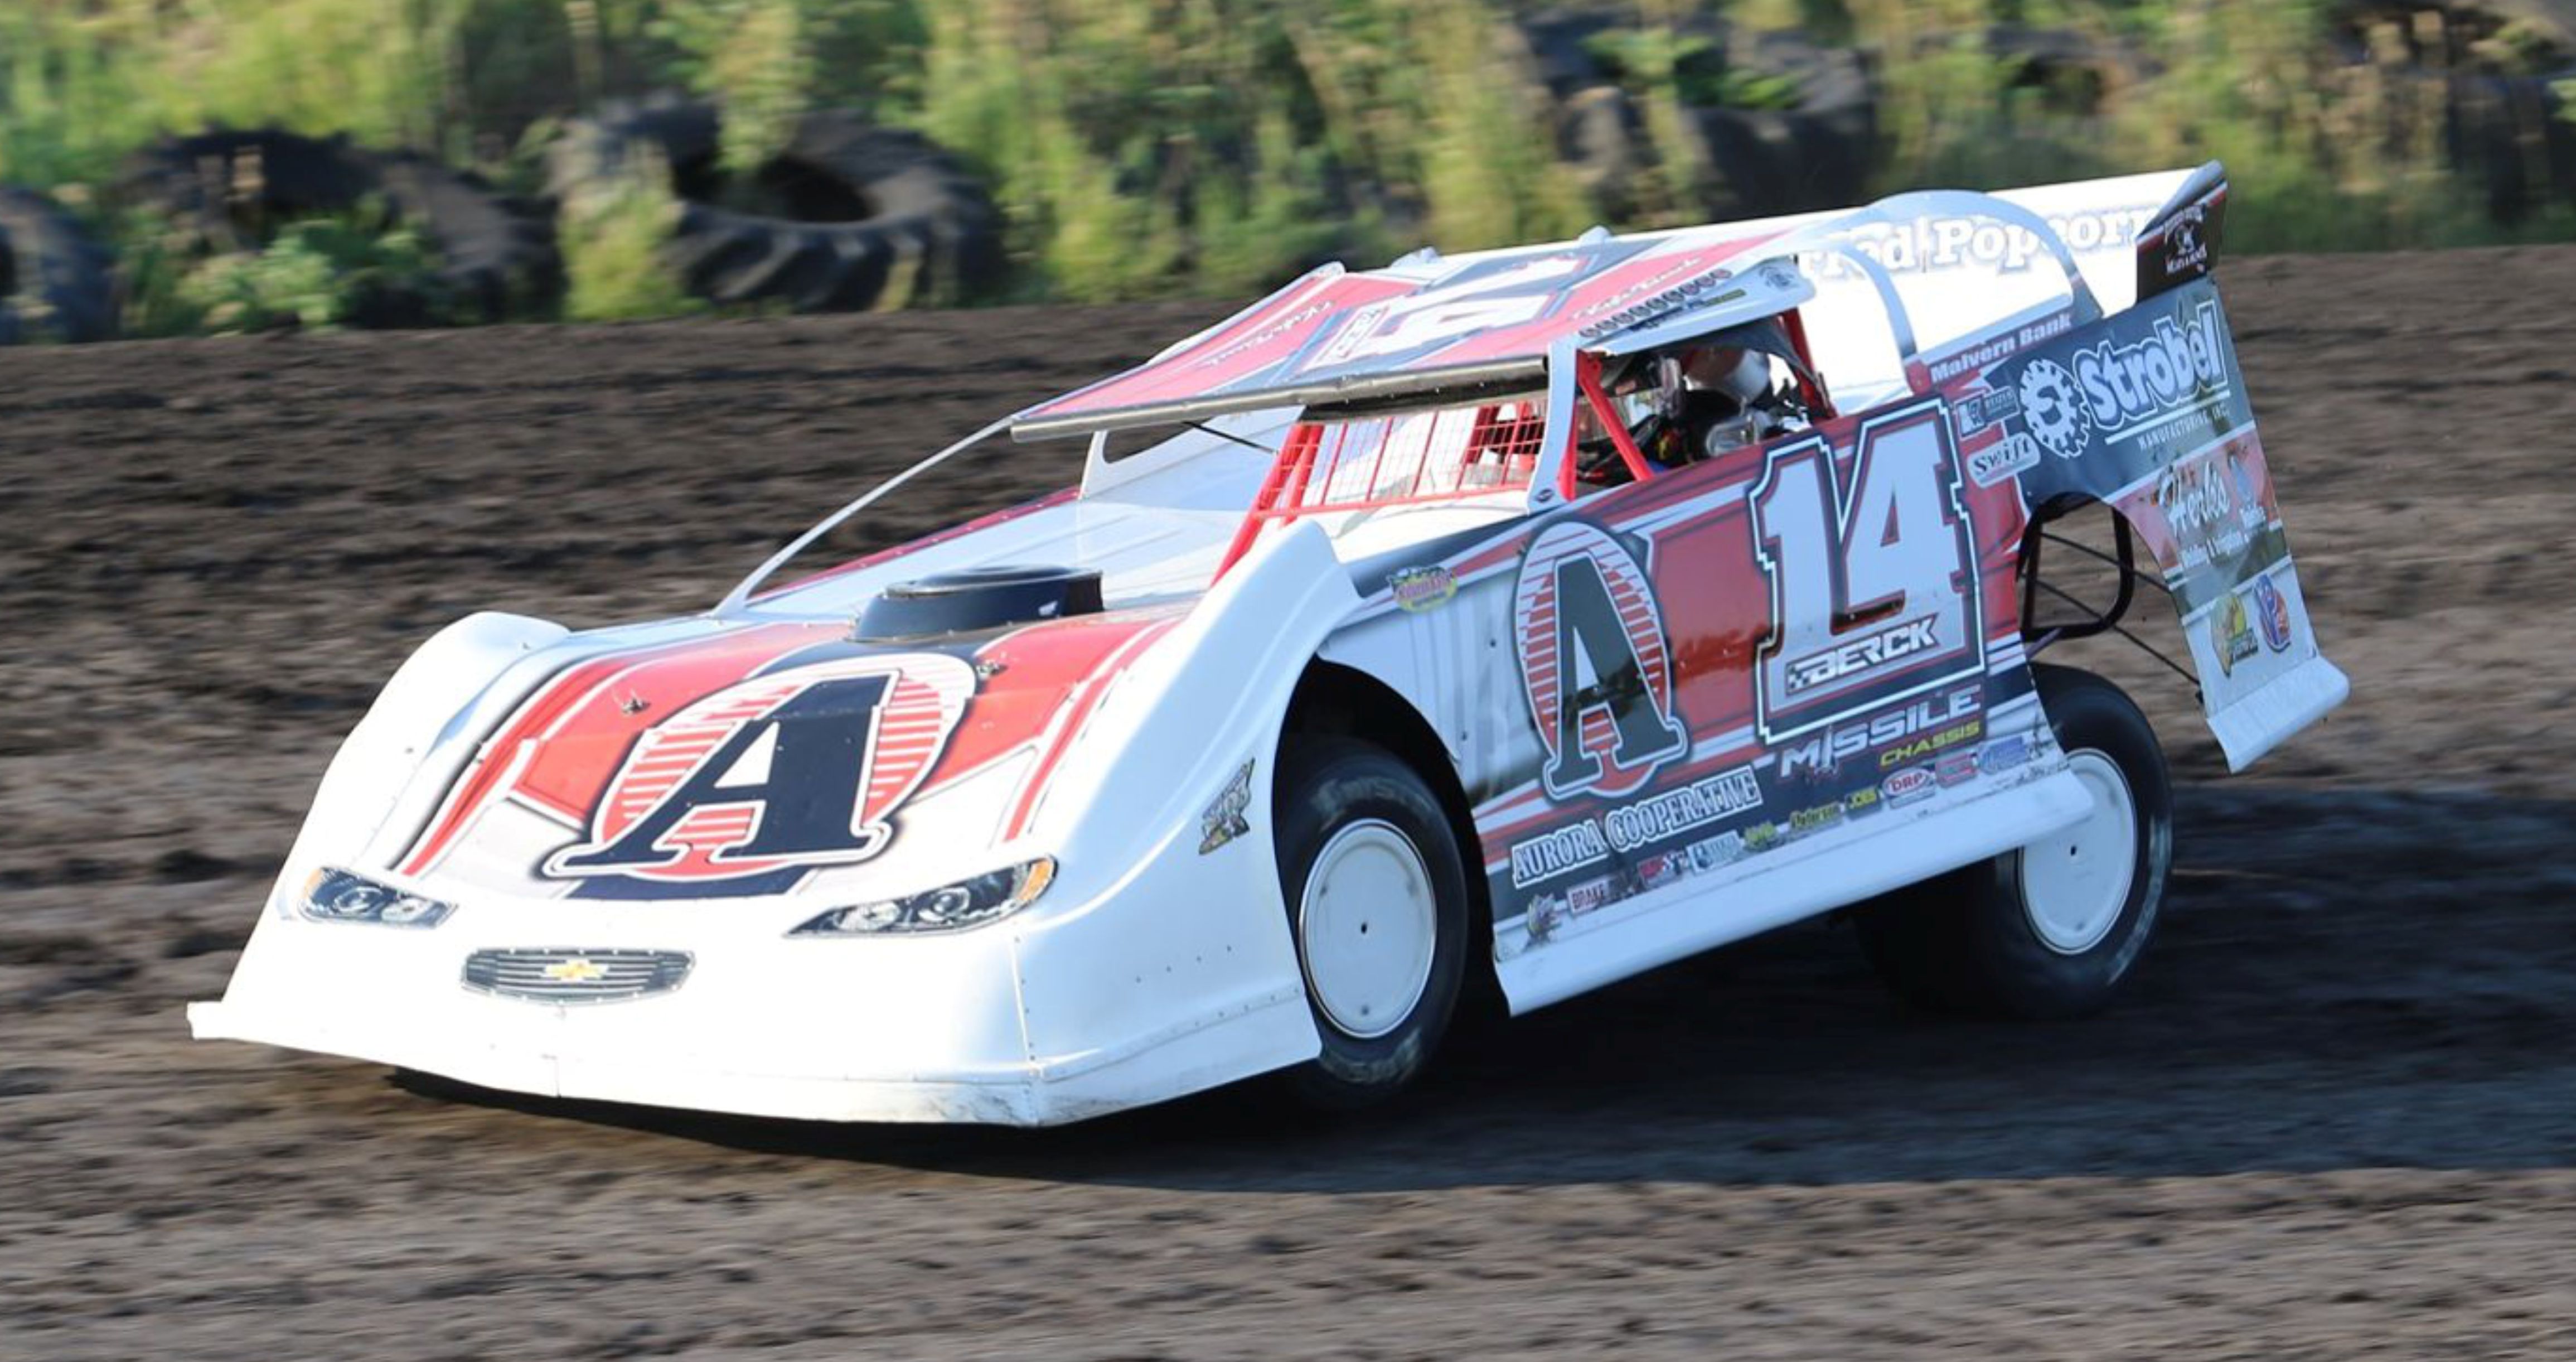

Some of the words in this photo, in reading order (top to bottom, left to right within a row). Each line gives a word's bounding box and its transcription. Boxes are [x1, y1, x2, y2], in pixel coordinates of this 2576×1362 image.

[1929, 336, 2016, 383] Malvern
[2018, 312, 2073, 347] Bank
[2074, 303, 2226, 426] Strobel
[1756, 414, 1971, 715] 14
[1547, 551, 1686, 794] A
[1799, 615, 1939, 686] BERCK
[552, 672, 899, 873] A
[1780, 684, 1982, 777] MISSILE
[1880, 721, 1981, 767] CHASSIS
[1513, 820, 1607, 885] AURORA
[1607, 767, 1761, 850] COOPERATIVE
